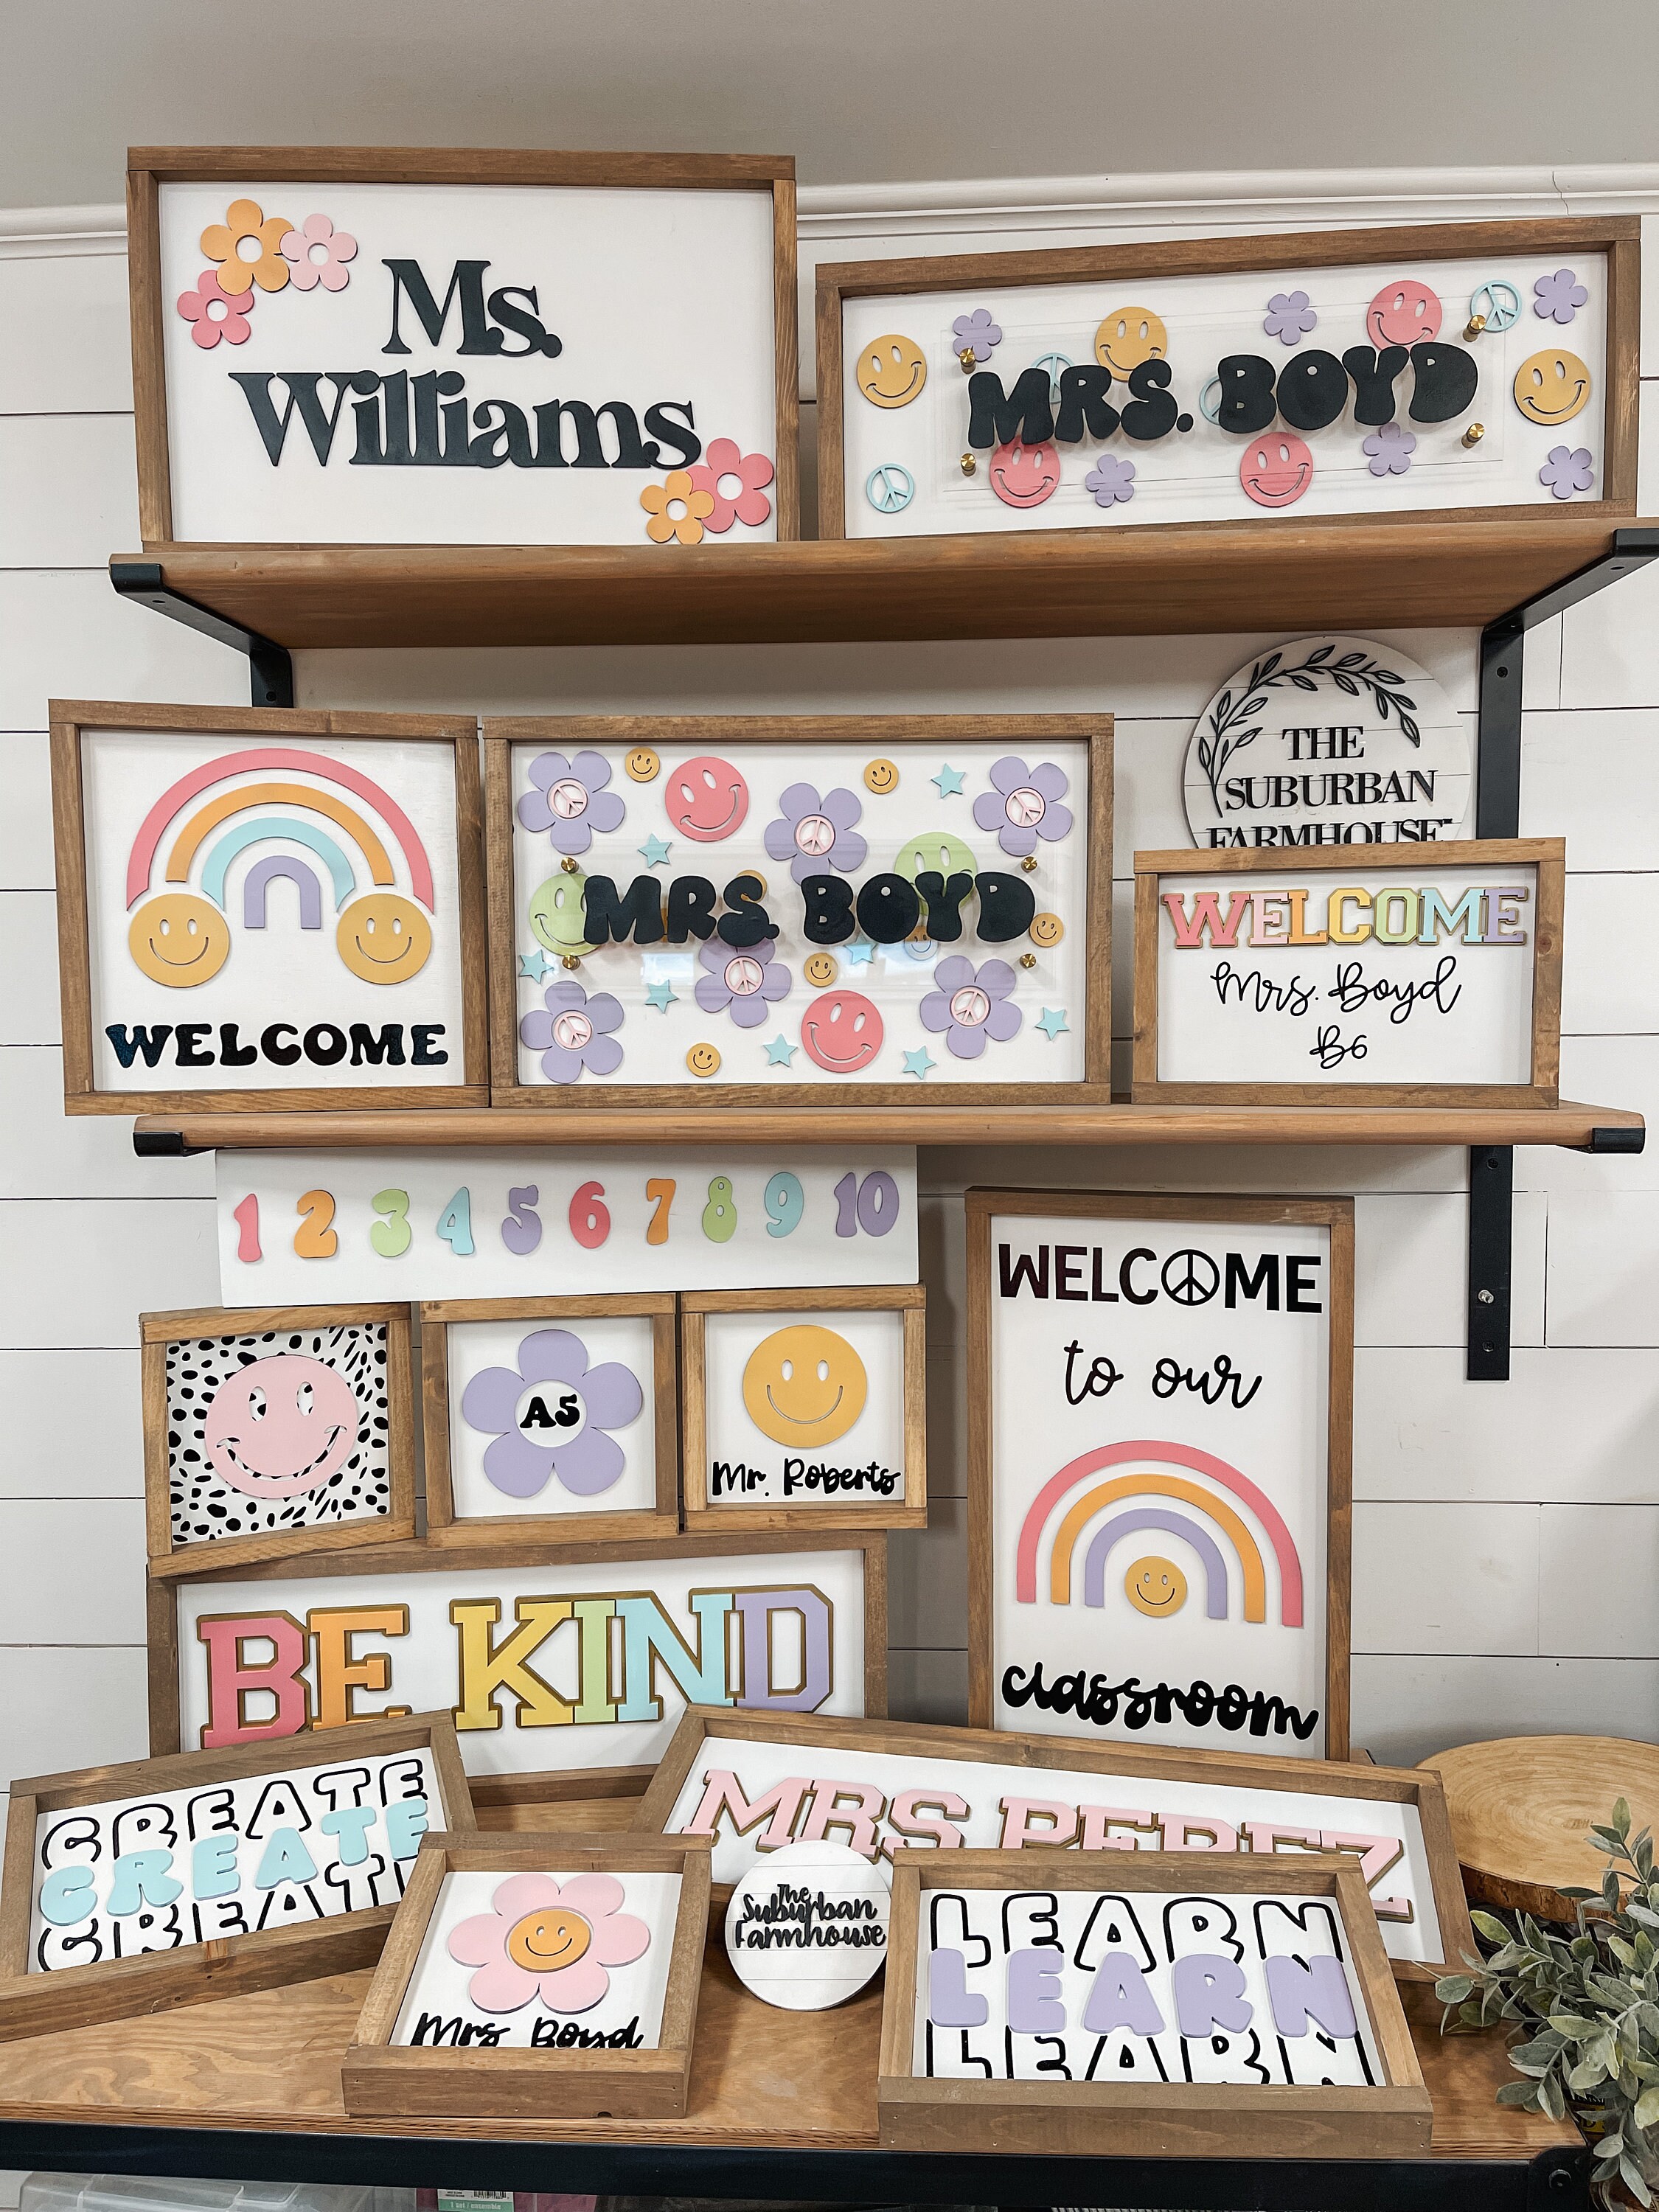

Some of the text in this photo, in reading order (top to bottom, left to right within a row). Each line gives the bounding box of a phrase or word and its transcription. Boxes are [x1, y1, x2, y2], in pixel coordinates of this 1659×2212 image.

[380, 258, 563, 358] Ms.
[228, 369, 702, 470] Williams
[967, 341, 1479, 449] MRS. BOYD
[1281, 726, 1366, 761] THE
[1222, 770, 1439, 810] SUBURBAN
[800, 870, 1035, 945] BOYD
[1161, 886, 1528, 950] WELCOME
[1209, 956, 1462, 1024] Mrs. Boyd
[105, 1022, 449, 1068] WELCOME
[1309, 1024, 1368, 1070] B6
[233, 1170, 900, 1263] 1 2 3 4 5 6 7 8 9 10
[1063, 1339, 1262, 1409] to our
[519, 1394, 580, 1429] A5
[712, 1458, 902, 1498] Mr. Roberts
[197, 1582, 835, 1749] BE KIND
[1001, 1661, 1320, 1741] classroom
[41, 1759, 428, 1870] CREATE
[681, 1769, 972, 1865] MRS
[39, 1798, 429, 1926] CREATE
[776, 1883, 811, 1904] The
[38, 1853, 406, 1972] CREAT
[734, 1919, 887, 1950] Farmhouse
[742, 1891, 878, 1924] Suburban
[930, 1893, 1343, 1974] LEARN
[928, 1947, 1359, 2039] LEARN
[530, 2015, 644, 2049] Boyd
[925, 2019, 1377, 2087] LEARN
